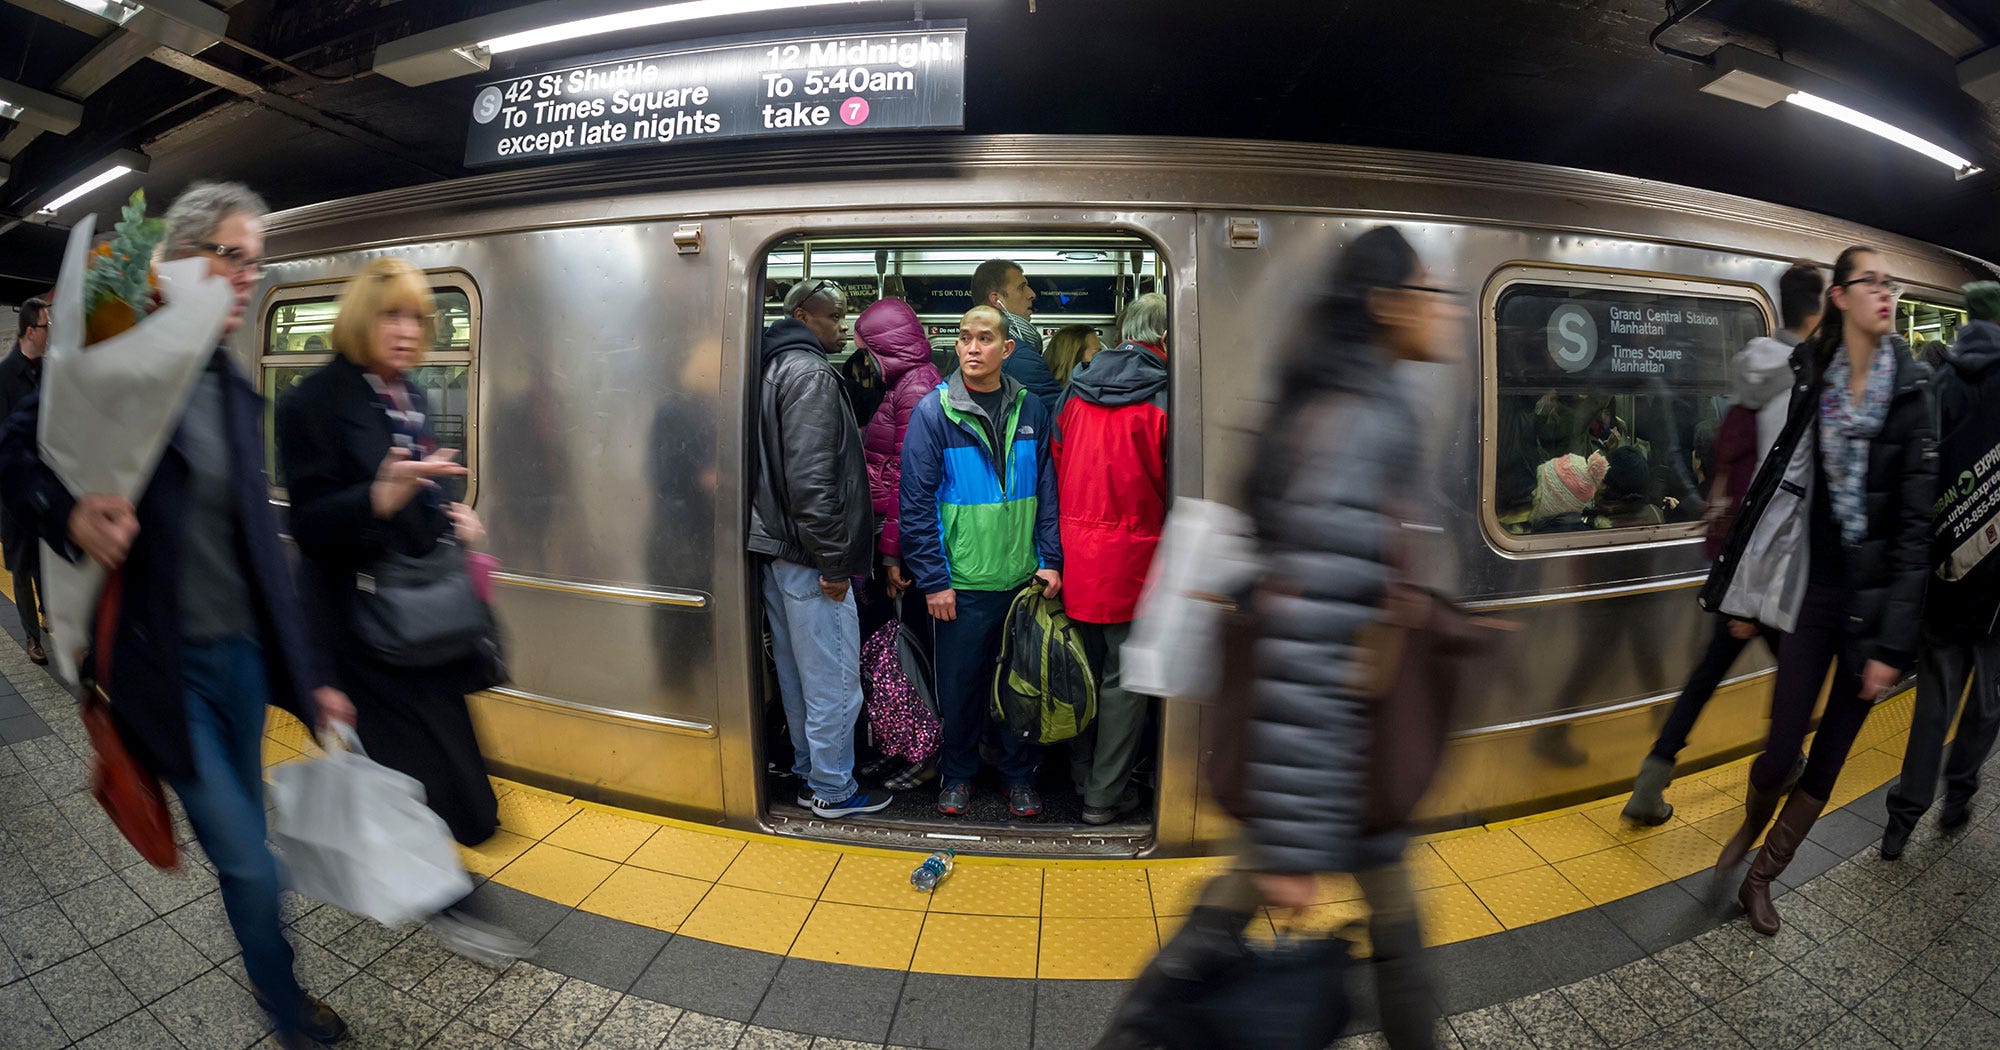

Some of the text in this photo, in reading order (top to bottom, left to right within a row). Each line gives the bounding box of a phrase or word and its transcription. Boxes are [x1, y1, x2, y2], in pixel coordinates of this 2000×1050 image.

[767, 37, 953, 70] 12 Midnight
[505, 61, 658, 102] 42 St Shuttle
[762, 67, 913, 97] To 5:40am
[480, 94, 495, 116] S
[502, 85, 709, 129] To Times Square
[762, 102, 862, 128] take 7
[497, 110, 721, 156] except late nights
[1610, 306, 1719, 325] Grand Central Station
[1610, 320, 1664, 335] Manhattan
[1558, 312, 1588, 362] S
[1611, 345, 1682, 361] Times Square
[1611, 358, 1665, 373] Manhattan
[1953, 487, 2000, 538] 212-855-55
